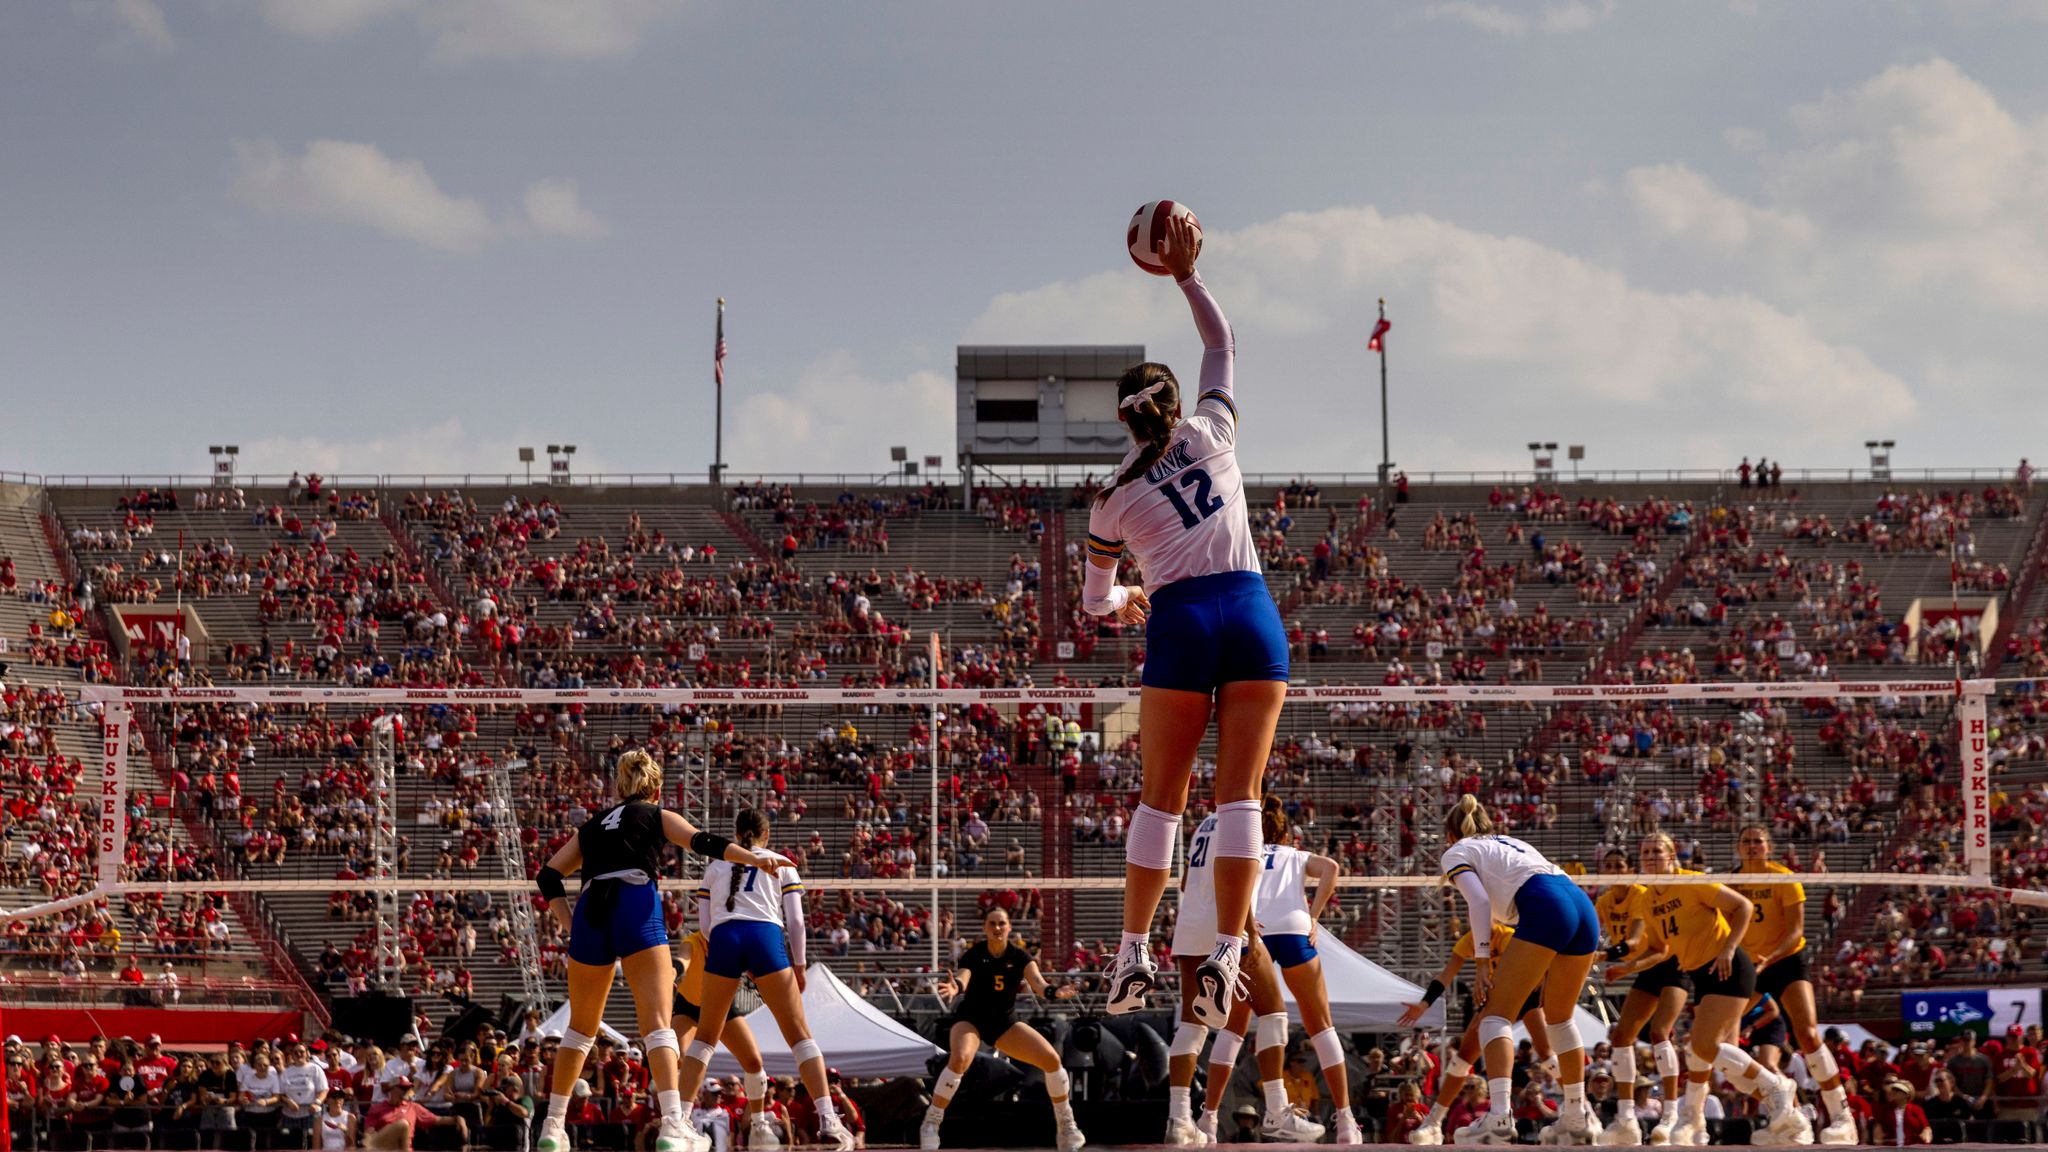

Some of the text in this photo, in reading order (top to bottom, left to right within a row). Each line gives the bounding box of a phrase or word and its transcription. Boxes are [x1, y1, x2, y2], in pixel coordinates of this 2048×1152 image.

[218, 462, 229, 472] 15
[1144, 438, 1198, 486] UNK
[1159, 468, 1225, 530] 12
[123, 689, 236, 698] HUSKER VOLLEYBALL
[406, 690, 522, 699] HUSKER VOLLEYBALL
[693, 691, 809, 700] HUSKER VOLLEYBALL
[980, 690, 1096, 699] HUSKER VOLLEYBALL
[1314, 688, 1382, 697] VOLLEYBALL
[1601, 686, 1669, 696] VOLLEYBALL
[102, 723, 120, 853] HUSKERS
[1970, 719, 1986, 848] HUSKERS
[600, 805, 626, 831] 4
[1190, 836, 1210, 867] 21
[1662, 915, 1680, 939] 14
[994, 975, 1005, 991] 5
[1915, 1000, 1929, 1016] 0
[2010, 1001, 2027, 1025] 7
